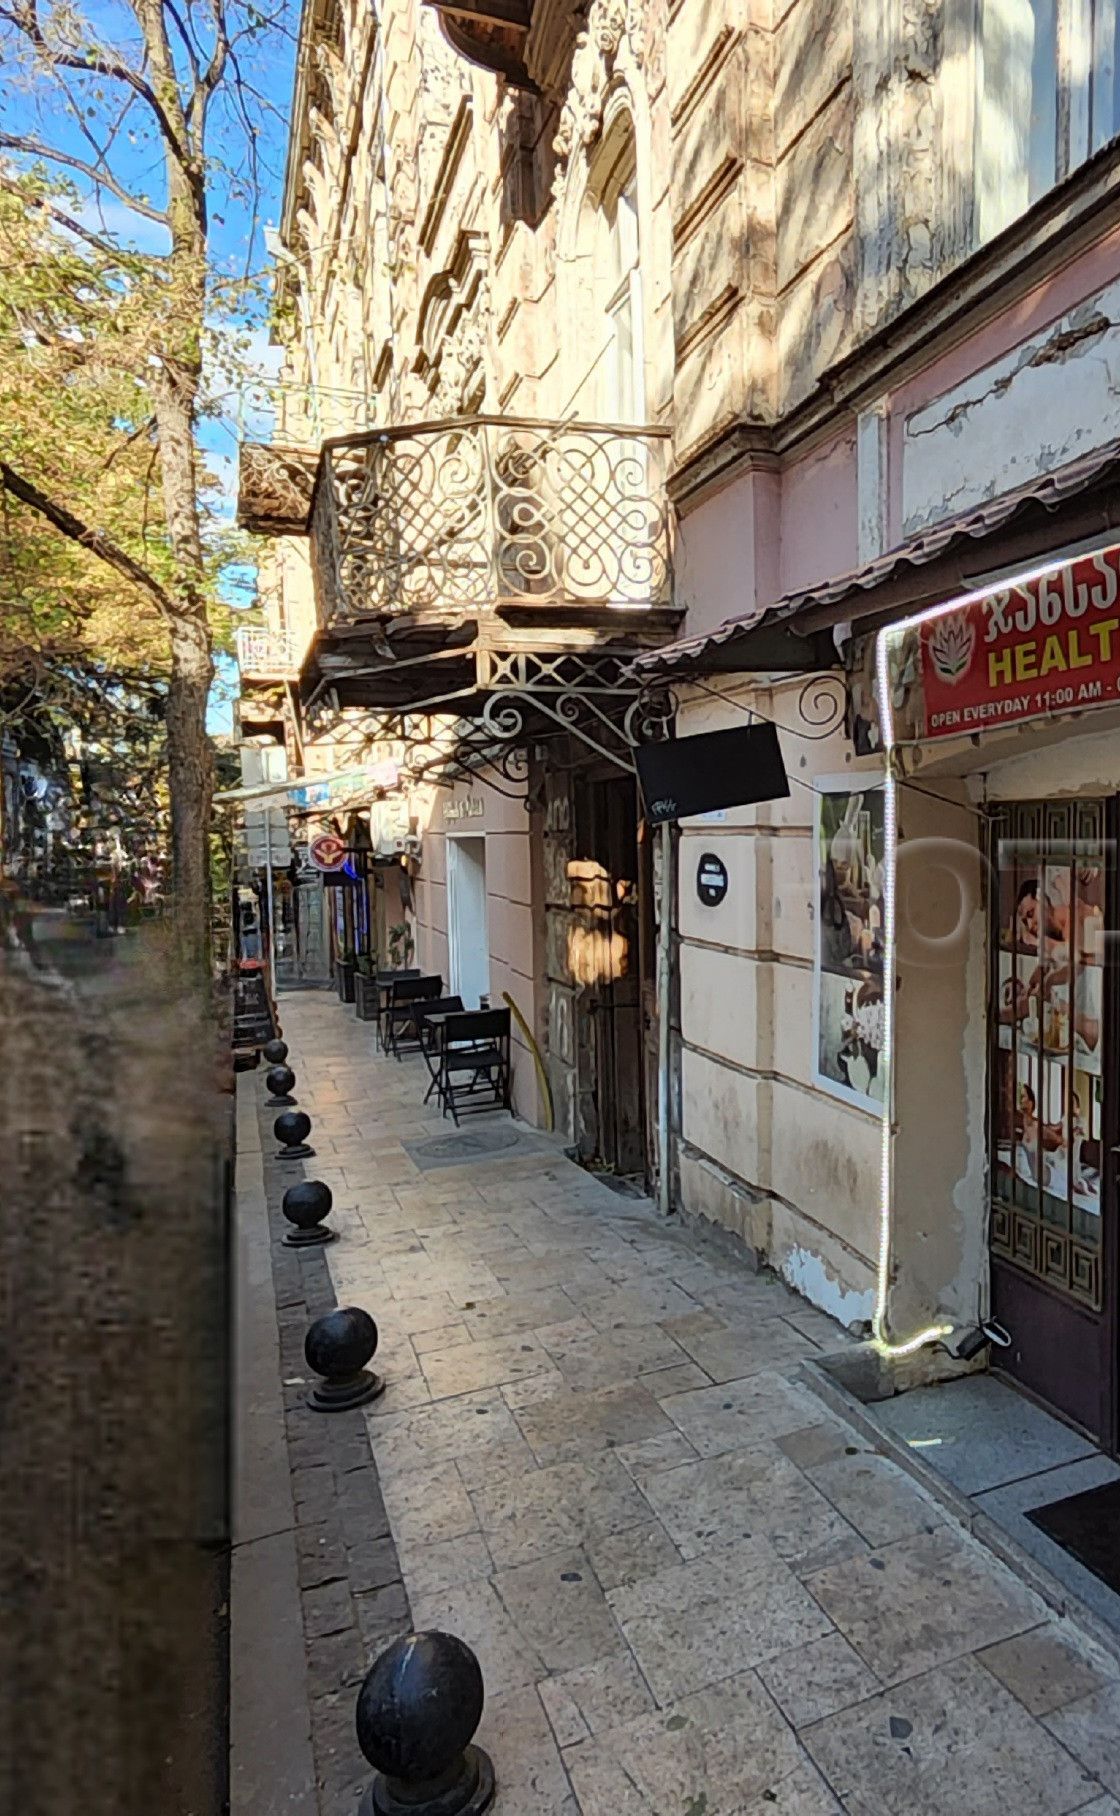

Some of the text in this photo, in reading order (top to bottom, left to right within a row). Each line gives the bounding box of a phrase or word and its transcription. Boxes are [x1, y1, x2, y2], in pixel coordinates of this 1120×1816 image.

[931, 710, 960, 729] OPEN
[963, 695, 1031, 722] EVERYDAY
[1036, 686, 1073, 709] 11:00
[1078, 680, 1101, 702] AM
